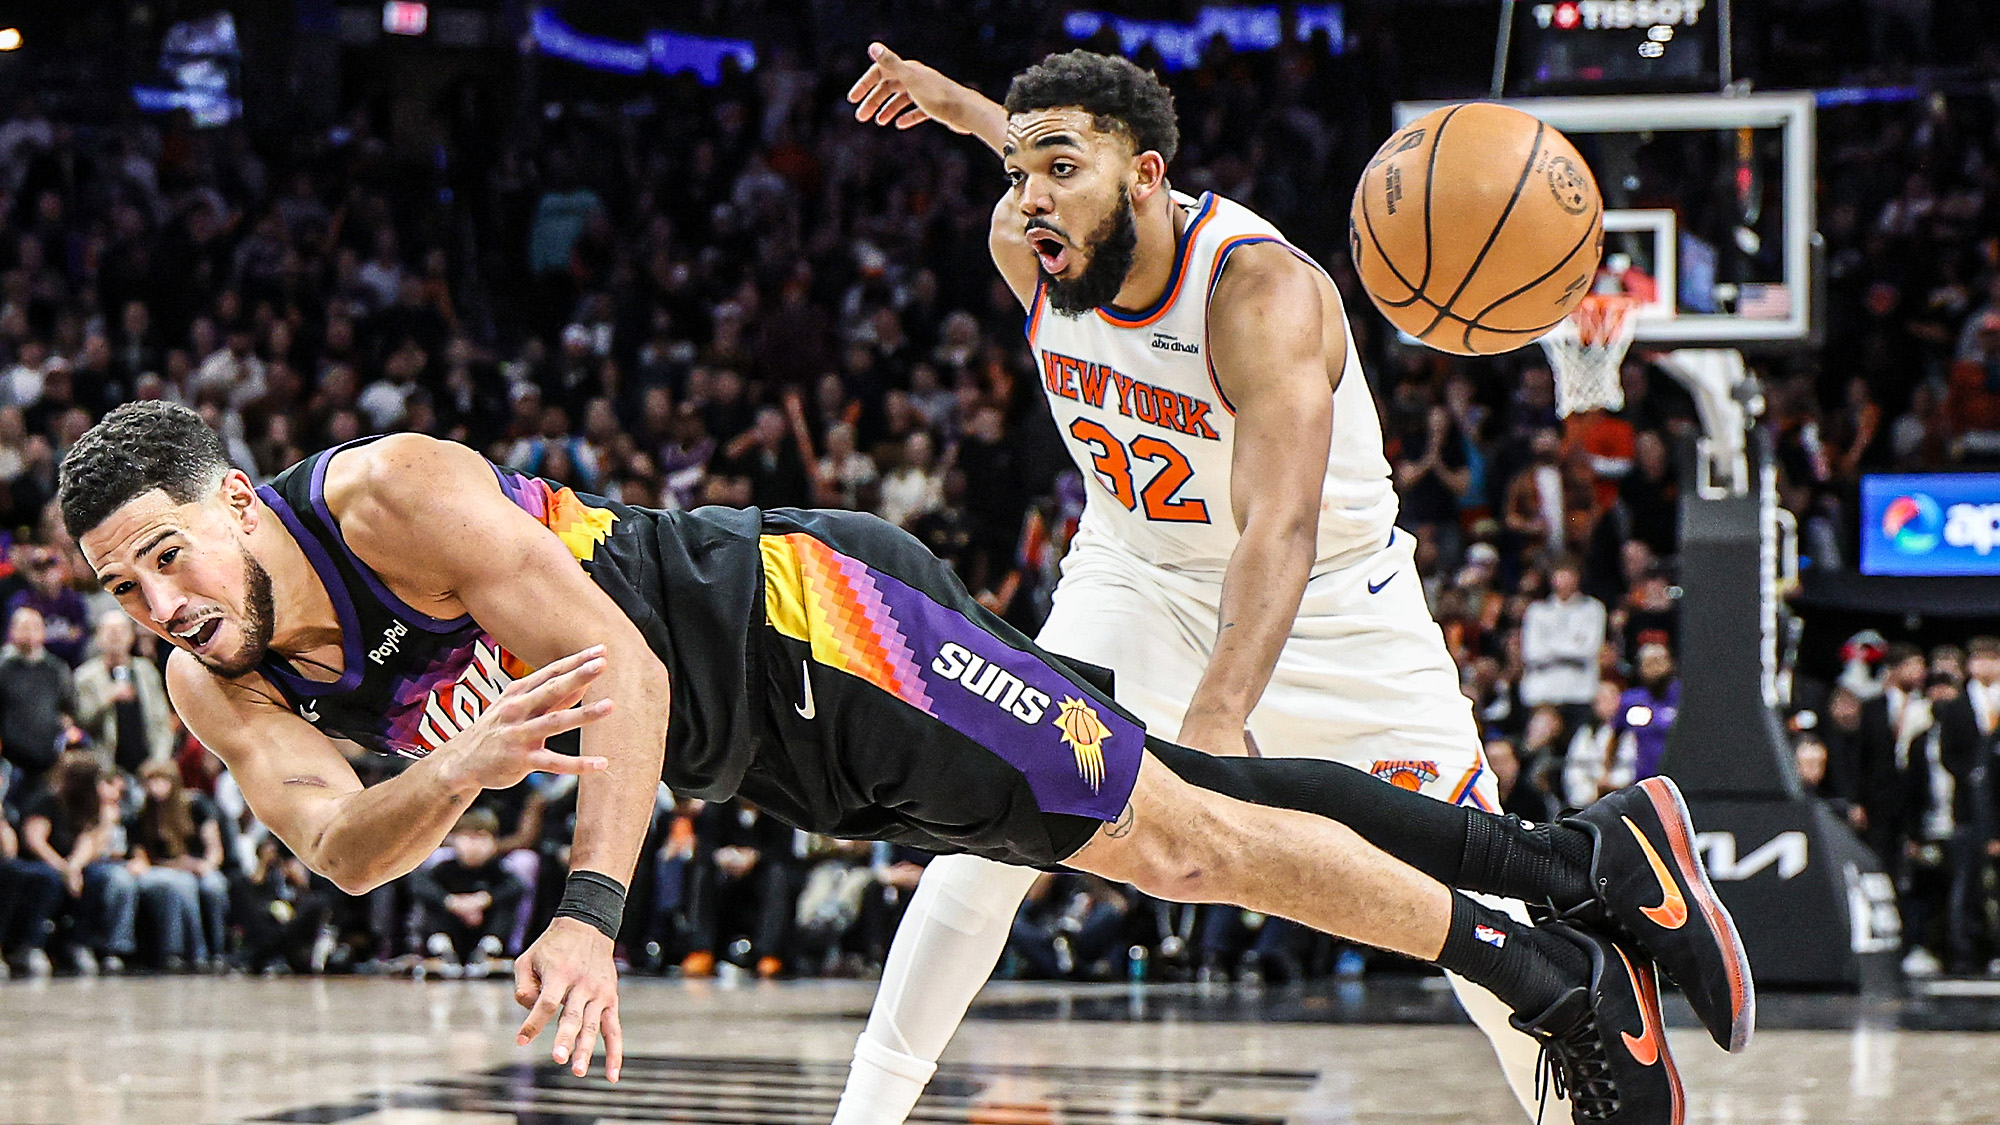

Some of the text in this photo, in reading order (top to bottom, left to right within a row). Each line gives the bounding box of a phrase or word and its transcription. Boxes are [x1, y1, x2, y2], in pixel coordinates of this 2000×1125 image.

[1152, 338, 1199, 354] abu dhabi
[1042, 350, 1221, 441] NEW YORK
[1069, 416, 1212, 524] 32
[368, 619, 408, 665] PayPal
